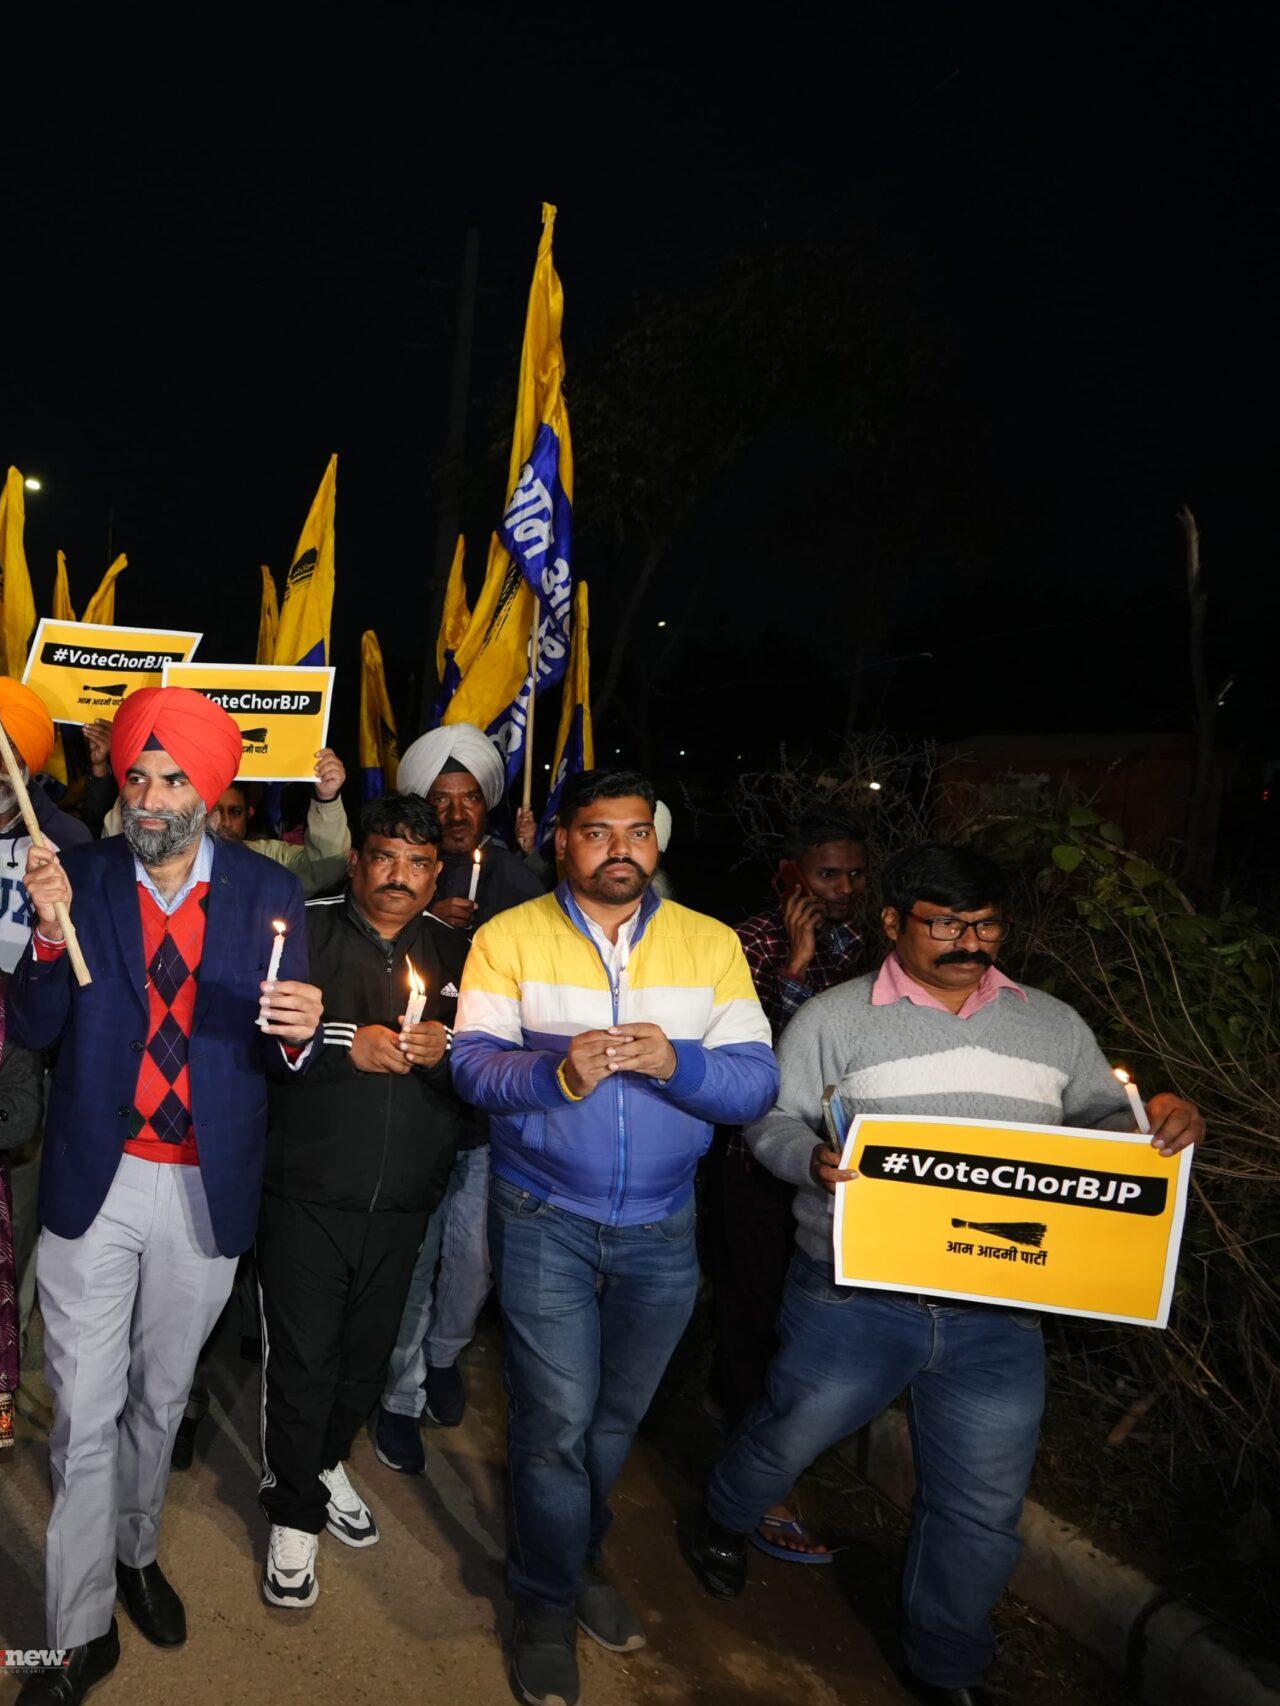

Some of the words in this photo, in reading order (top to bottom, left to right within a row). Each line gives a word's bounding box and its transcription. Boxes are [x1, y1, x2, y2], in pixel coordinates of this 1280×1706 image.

[53, 648, 172, 669] #VoteChorBJP
[882, 1153, 1142, 1205] #VoteChorBJP
[946, 1241, 975, 1255] आम
[977, 1245, 1018, 1262] आदमी
[1020, 1250, 1048, 1266] पार्टी
